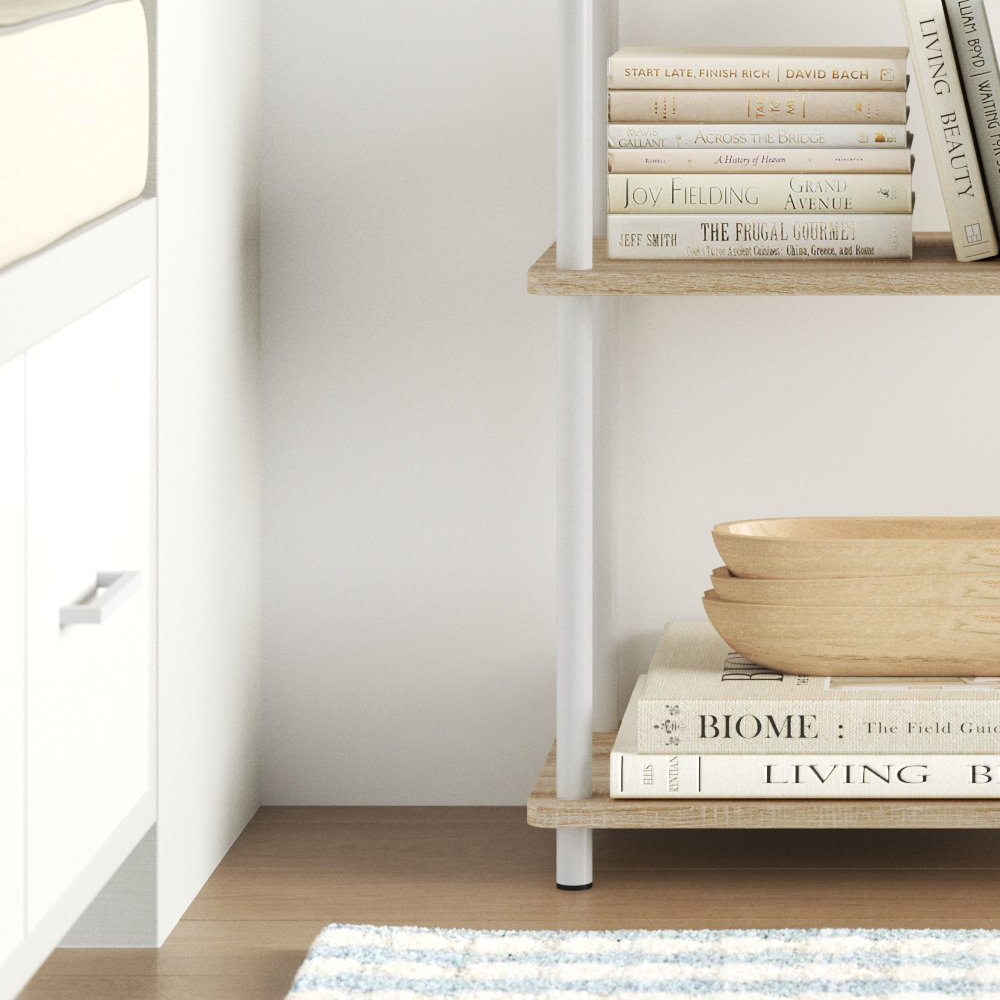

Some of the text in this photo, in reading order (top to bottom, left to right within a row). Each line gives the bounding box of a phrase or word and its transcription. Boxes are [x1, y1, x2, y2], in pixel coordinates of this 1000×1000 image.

[624, 68, 770, 79] START LATE, FINISH RICH
[785, 69, 869, 80] DAVID BACH
[967, 37, 987, 69] BOYD
[978, 79, 1000, 131] WAITING
[919, 17, 976, 200] LIVING BEAUTY
[618, 138, 667, 148] GALLANT
[694, 129, 826, 144] ACROSS THE BRIDGE
[714, 155, 786, 167] A History of Heaven
[671, 177, 759, 205] FIELDING
[789, 176, 847, 193] GRAND
[784, 194, 853, 210] AVENUE
[618, 233, 677, 247] JEFF SMITH
[700, 221, 857, 242] THE FRUGAL GOURMET
[698, 714, 819, 739] BIOME
[863, 722, 898, 734] The
[907, 722, 951, 734] Field
[642, 764, 653, 785] ELLIS
[763, 765, 932, 784] LIVING
